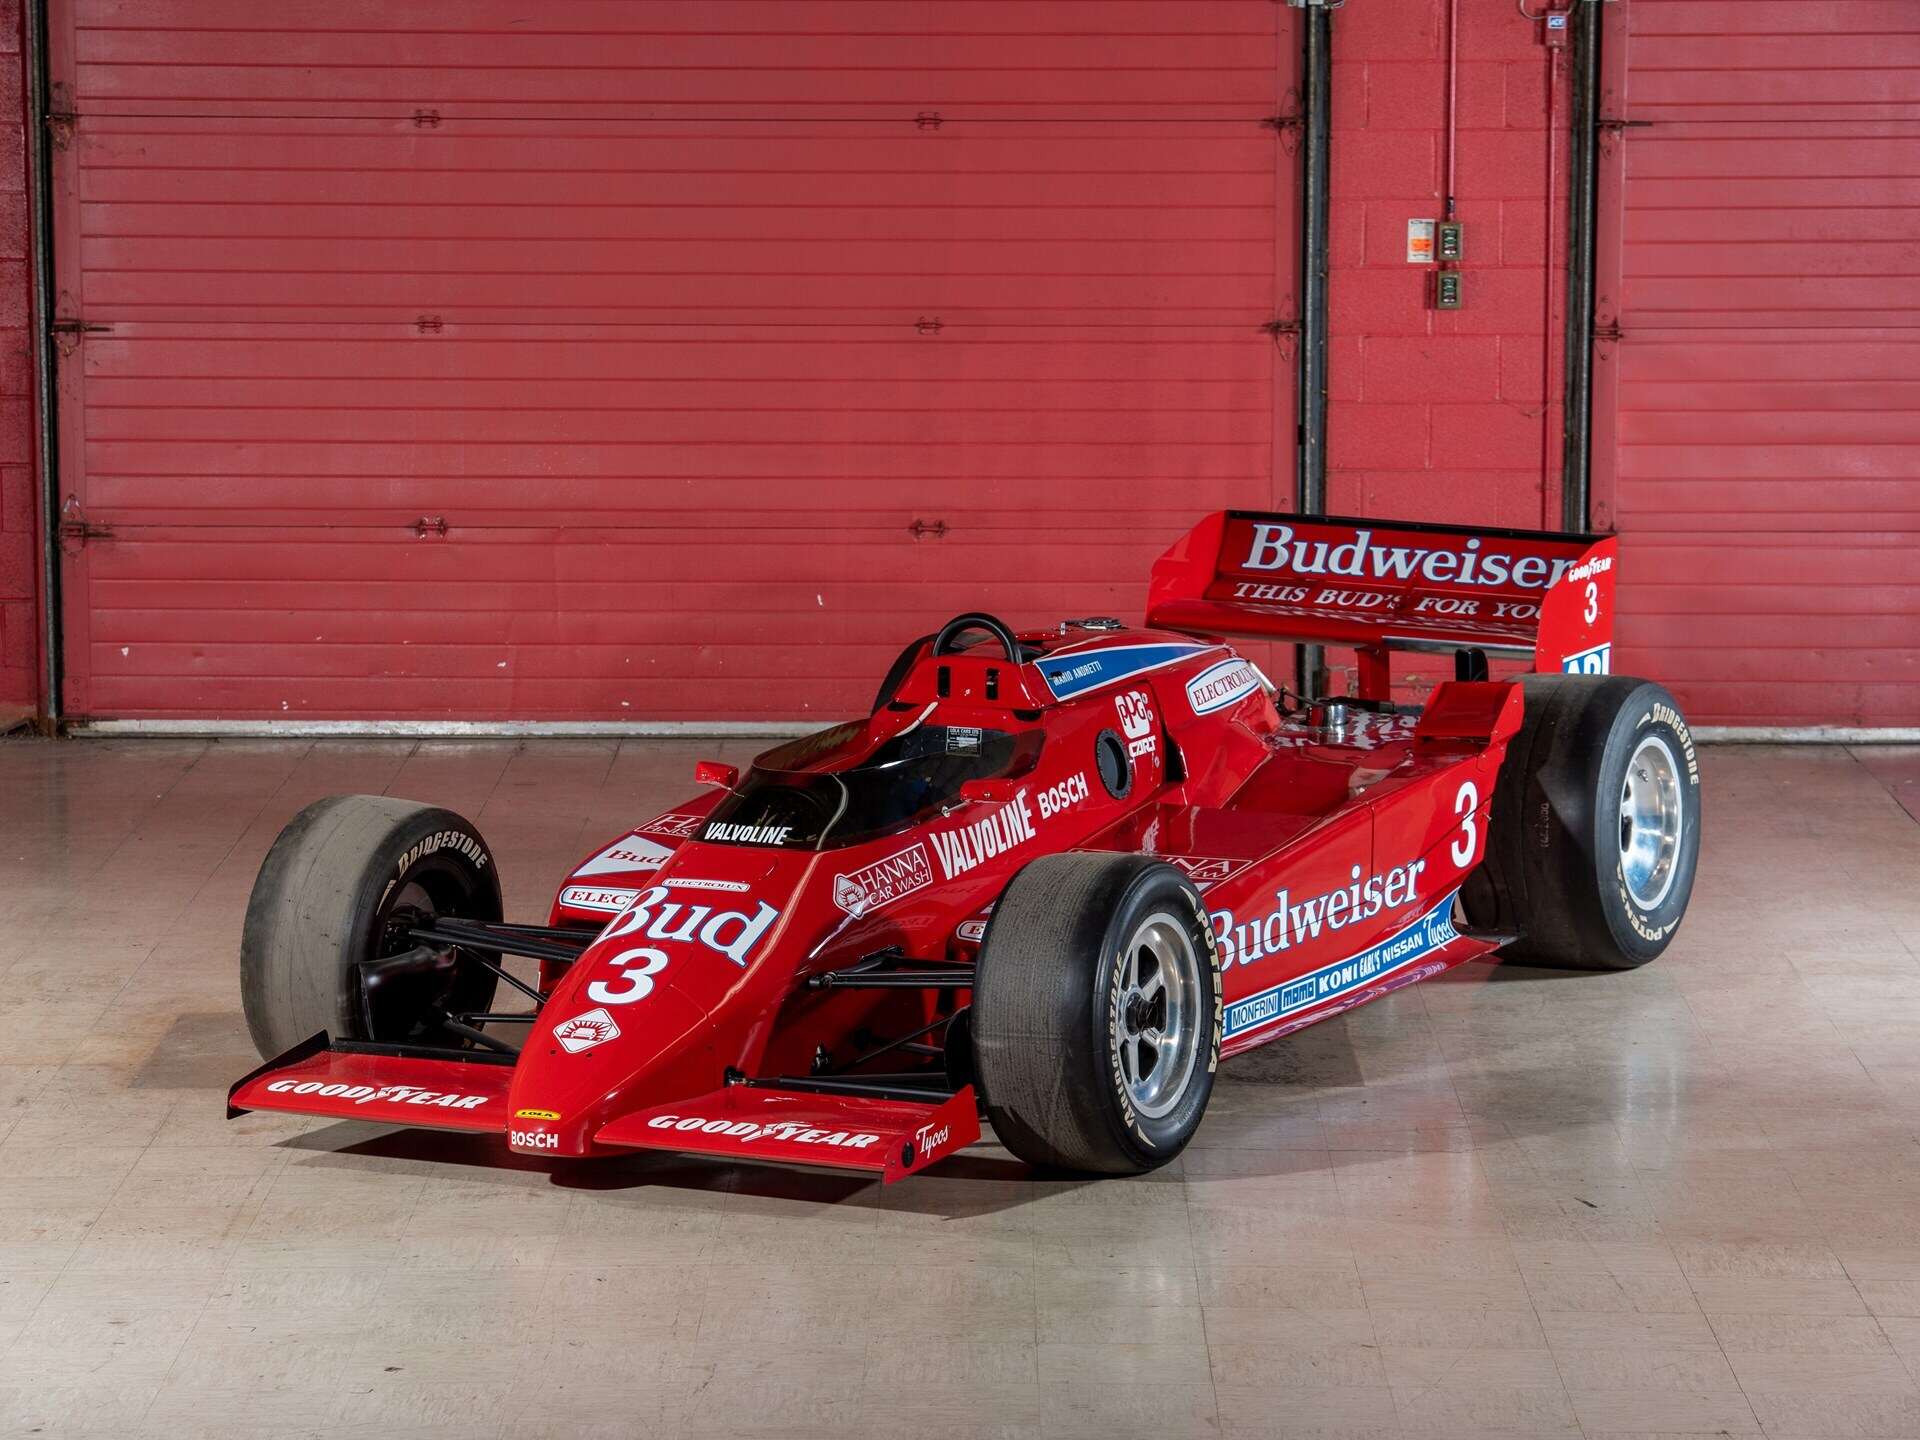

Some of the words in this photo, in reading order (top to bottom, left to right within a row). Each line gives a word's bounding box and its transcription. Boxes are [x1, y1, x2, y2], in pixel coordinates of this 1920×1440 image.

[1241, 523, 1574, 590] Budweiser
[1233, 582, 1310, 602] THIS
[1414, 596, 1480, 616] FOR
[1583, 581, 1598, 625] 3
[1073, 660, 1103, 680] ANDRETTI
[1193, 666, 1255, 707] ELECTROLUX
[1651, 702, 1700, 785] BRIDGESTONE
[1037, 772, 1089, 820] BOSCH
[703, 822, 793, 846] VALVOLINE
[929, 787, 1037, 881] VALVOLINE
[1451, 780, 1479, 869] 3
[398, 830, 488, 880] BRIDGESTONE
[857, 850, 926, 894] HANNA
[666, 879, 747, 891] ELECTROLUX
[868, 885, 895, 906] CAR
[895, 869, 930, 893] WASH
[586, 886, 780, 968] Bud
[1208, 858, 1426, 973] Budweiser
[588, 947, 669, 1005] 3
[1196, 907, 1223, 1073] POTENZA
[1232, 995, 1278, 1028] MONFRINI
[1318, 963, 1358, 994] KONI
[1382, 931, 1423, 964] NISSAN
[1423, 910, 1455, 952] Tycos
[1110, 950, 1136, 1129] BRIDGESTONE
[520, 1110, 553, 1118] LOLA
[510, 1130, 559, 1149] BOSCH
[915, 1122, 950, 1159] Tycos
